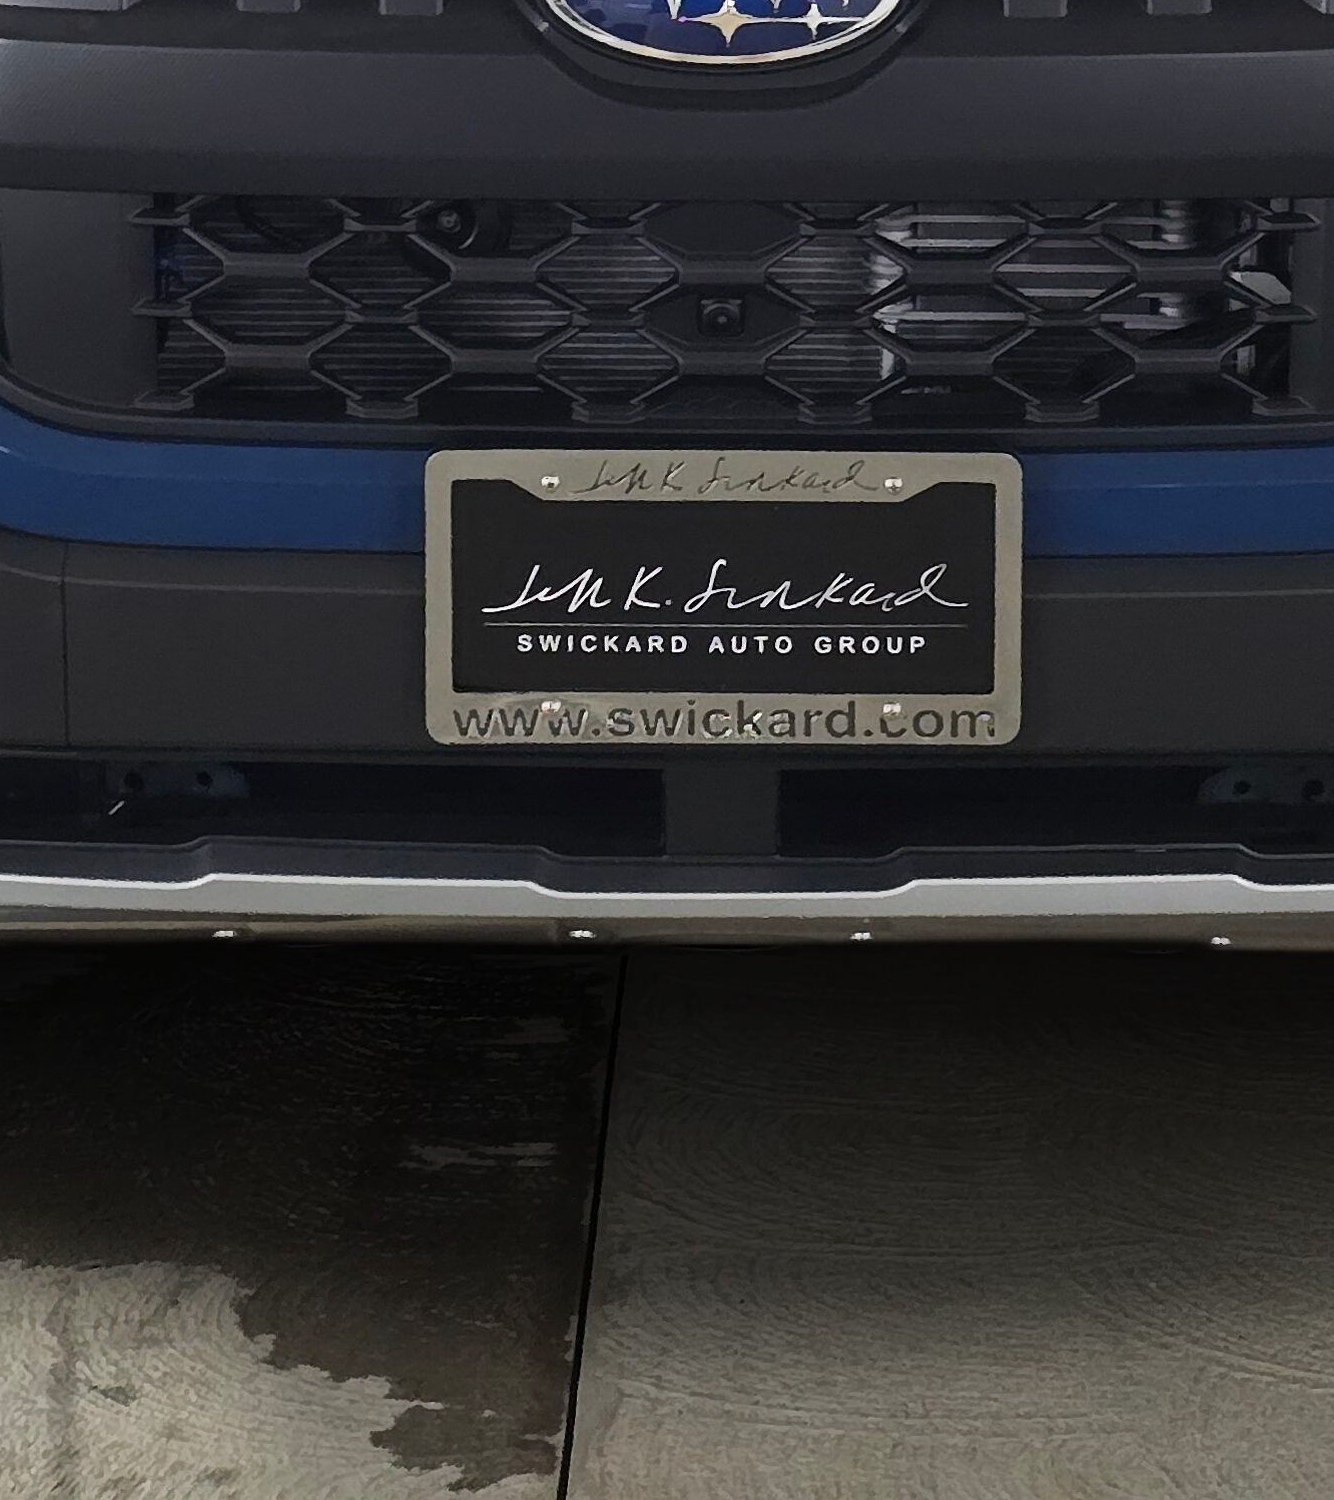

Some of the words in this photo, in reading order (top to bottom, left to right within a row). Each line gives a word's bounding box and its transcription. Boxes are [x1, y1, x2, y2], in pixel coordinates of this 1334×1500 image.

[516, 634, 689, 654] SWICKARD
[708, 635, 794, 655] AUTO
[814, 635, 927, 655] GROUP
[453, 699, 996, 739] www.swickard.com
